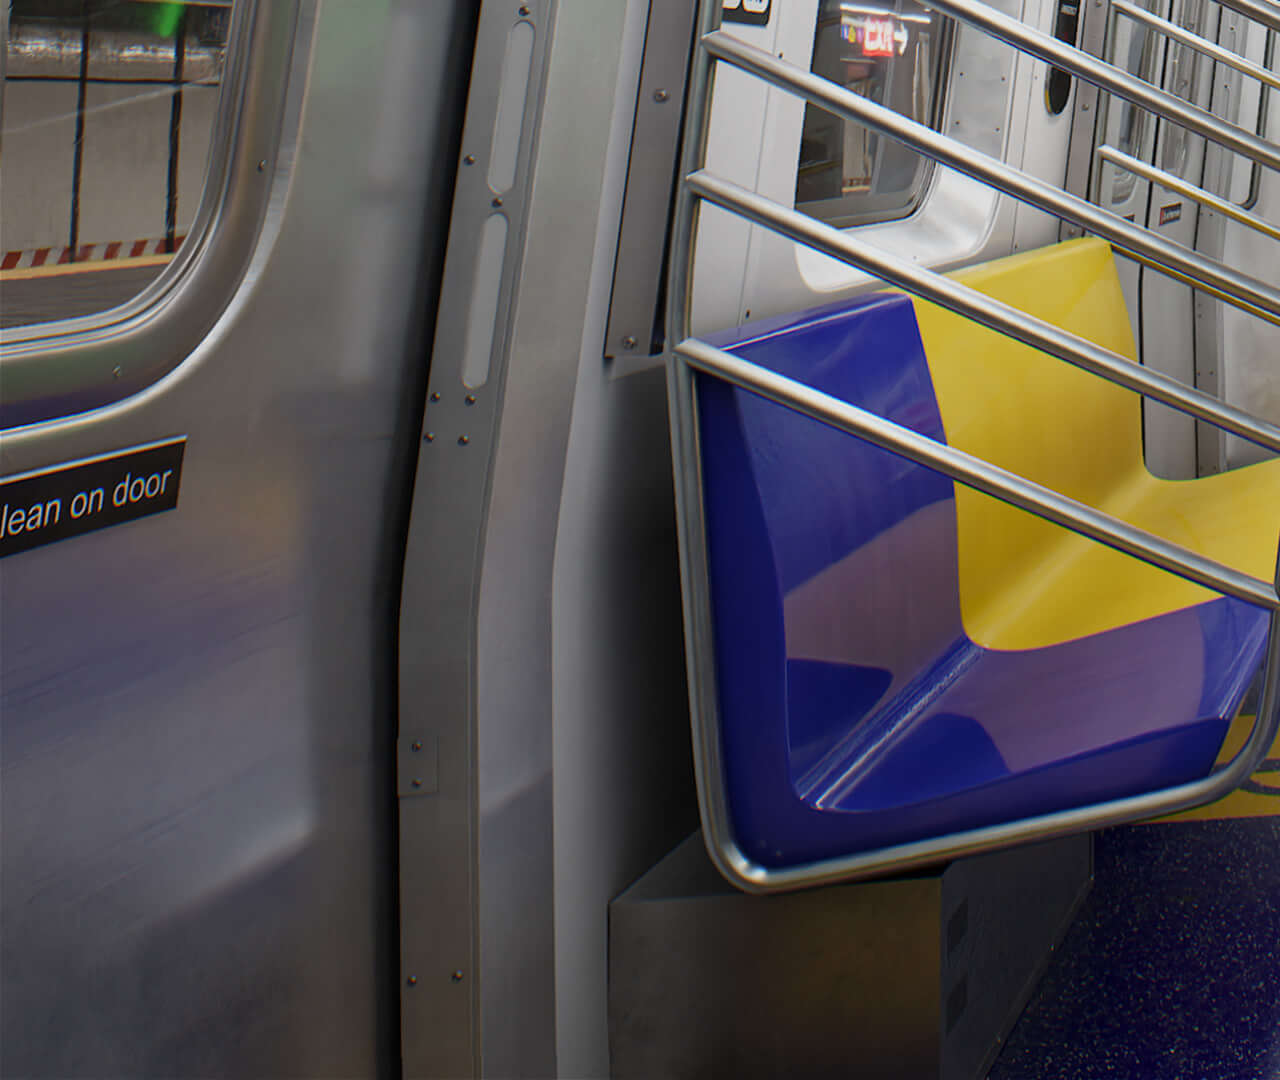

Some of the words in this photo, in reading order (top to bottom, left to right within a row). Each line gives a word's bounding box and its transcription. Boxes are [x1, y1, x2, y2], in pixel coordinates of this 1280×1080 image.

[0, 503, 61, 539] lean
[70, 487, 104, 519] on
[113, 472, 173, 507] door
